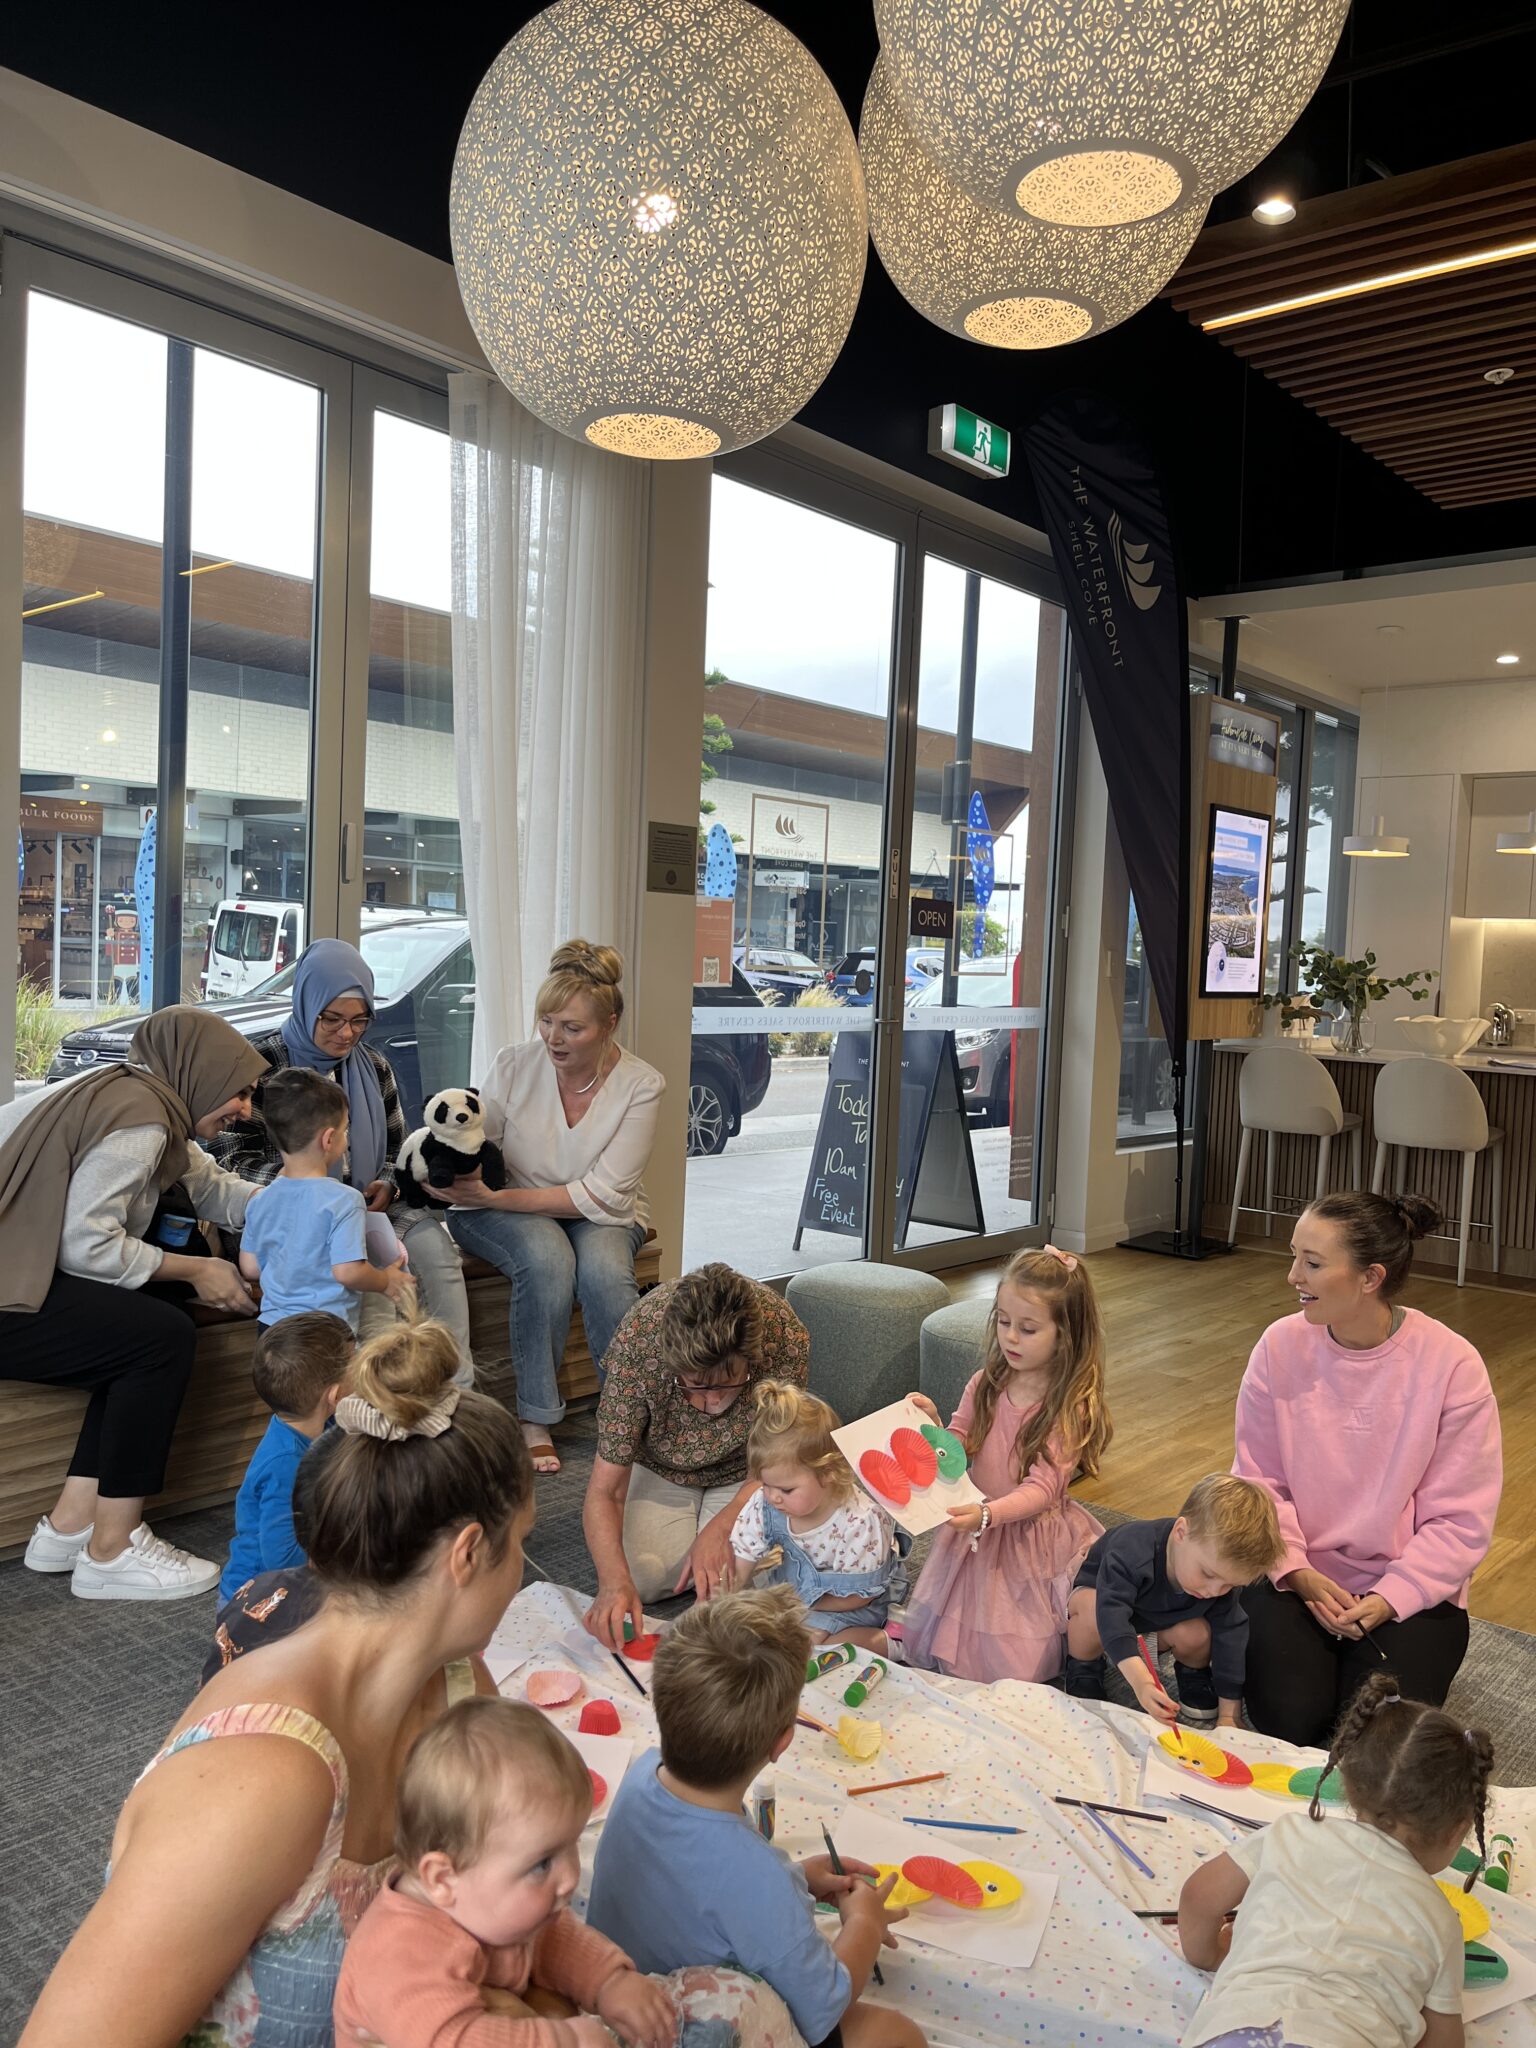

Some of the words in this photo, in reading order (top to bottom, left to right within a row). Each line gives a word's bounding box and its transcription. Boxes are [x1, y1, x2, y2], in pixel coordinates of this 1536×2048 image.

[1068, 520, 1086, 571] SHELL
[1081, 578, 1099, 625] COVE
[1070, 465, 1088, 506] THE
[1082, 516, 1124, 668] WATERFRONT
[54, 811, 95, 822] FOODS
[891, 849, 899, 898] PULL
[918, 910, 947, 928] OPEN
[858, 1058, 869, 1066] THE
[823, 1147, 857, 1180] 10am
[813, 1177, 840, 1206] Free
[820, 1204, 856, 1227] Event
